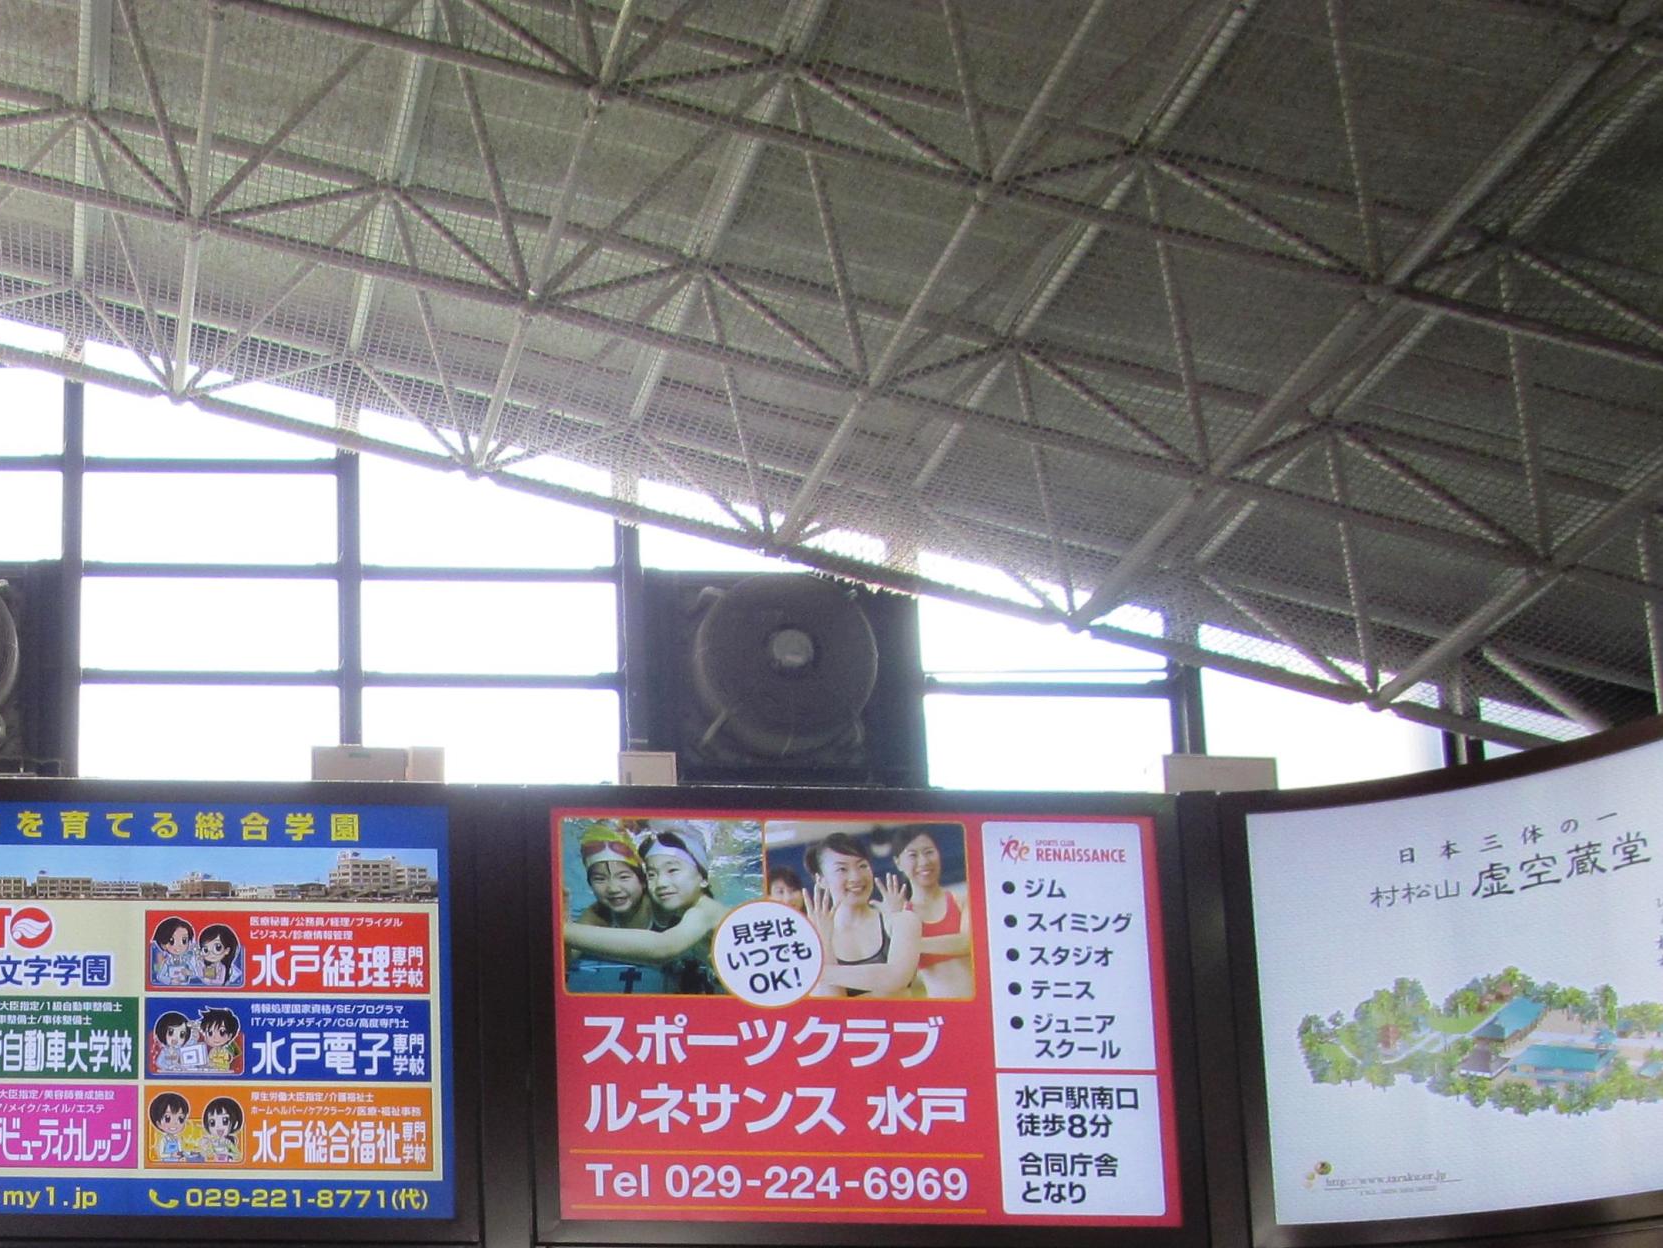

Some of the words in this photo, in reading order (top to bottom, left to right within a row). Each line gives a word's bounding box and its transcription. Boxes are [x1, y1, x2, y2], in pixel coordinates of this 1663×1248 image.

[1399, 813, 1618, 863] 日本三体の一
[1037, 849, 1125, 863] RENAISSANCE
[1371, 880, 1461, 908] 村松山
[1472, 833, 1651, 899] 虚空蔵堂
[1024, 879, 1066, 898] ジム
[732, 920, 797, 945] 見学は
[1028, 913, 1132, 933] スイミング
[252, 944, 389, 987] 水戸経理
[392, 946, 423, 966] 専門
[727, 941, 812, 971] いつでも
[1029, 945, 1114, 967] スタジオ
[393, 968, 423, 987] 学校
[749, 967, 804, 994] OK!
[1031, 980, 1095, 1000] テニス
[1033, 1014, 1115, 1035] ジュニア
[393, 1034, 424, 1053] 専門
[583, 1013, 944, 1068] スポーツクラブ
[1035, 1039, 1121, 1060] スクール
[252, 1031, 391, 1075] 水戸電子
[393, 1056, 424, 1075] 学校
[585, 1083, 844, 1136] ルネサンス
[867, 1086, 967, 1136] 水戸
[1015, 1086, 1139, 1111] 水戸駅南口
[403, 1122, 426, 1142] 専門
[1016, 1114, 1112, 1139] 徒歩8分
[252, 1120, 401, 1164] 水戸総合福祉
[403, 1144, 426, 1163] 学校
[1020, 1152, 1119, 1178] 合同庁舎
[585, 1163, 650, 1199] Tel
[665, 1164, 968, 1200] 029-224-6969
[1021, 1181, 1087, 1205] となり
[186, 1188, 428, 1209] 029-221-8771(代)
